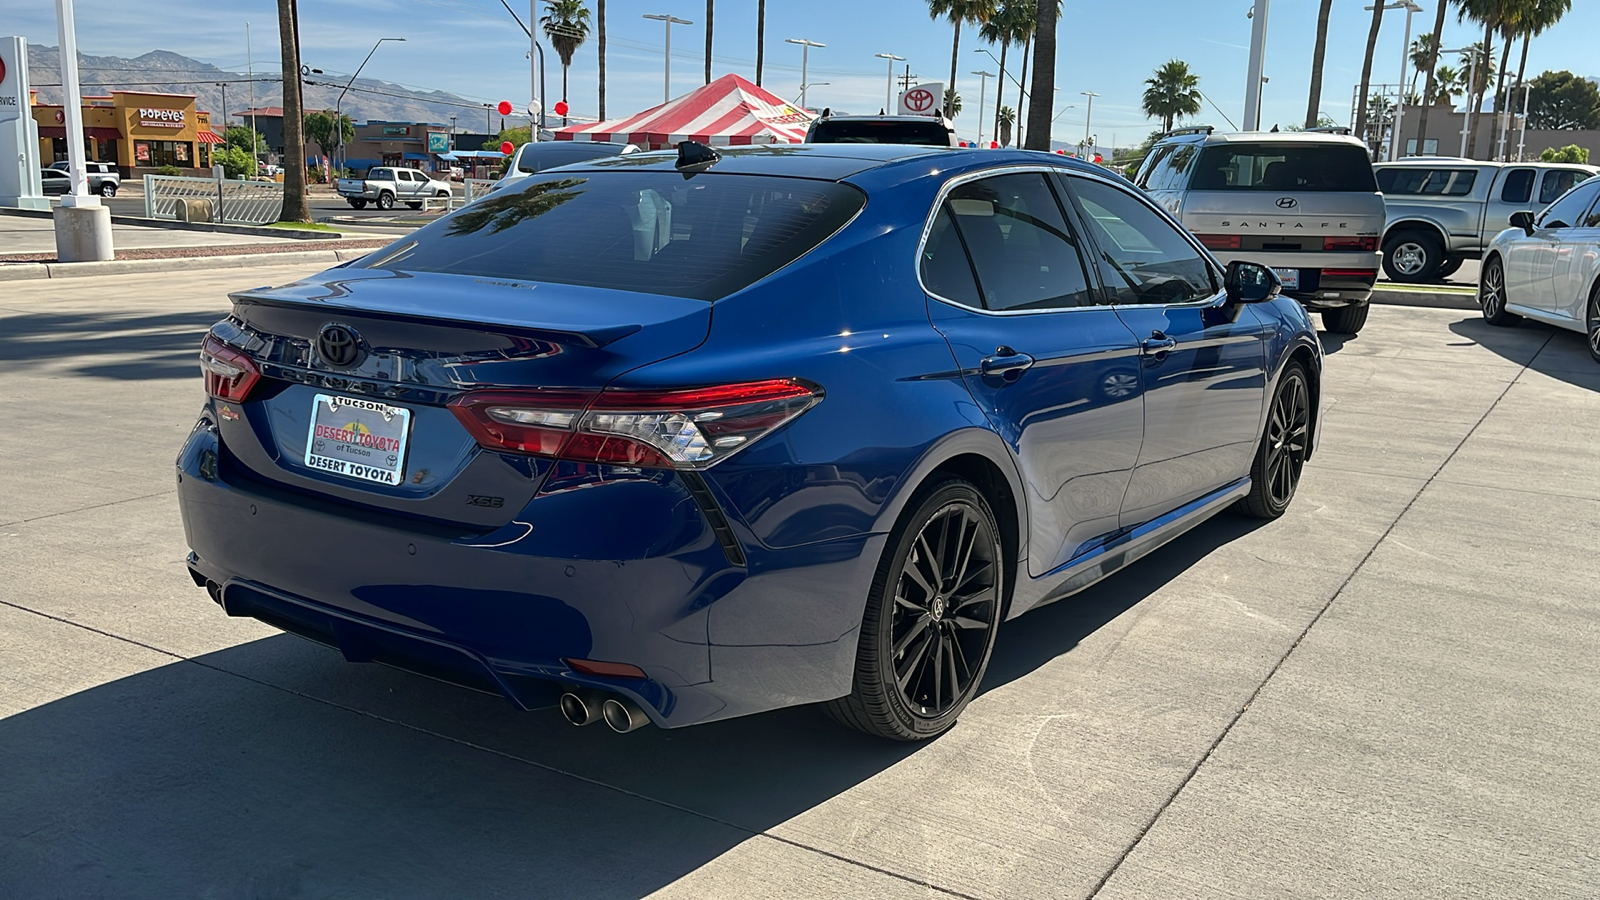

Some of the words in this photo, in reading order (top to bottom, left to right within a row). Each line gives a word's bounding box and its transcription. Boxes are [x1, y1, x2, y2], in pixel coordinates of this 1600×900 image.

[1221, 221, 1304, 229] SANTA
[337, 397, 384, 411] TUCSON
[316, 425, 355, 443] DESERT
[358, 431, 400, 453] TOYOTA
[346, 445, 371, 457] Tucson
[309, 455, 346, 472] DESERT
[349, 464, 394, 483] TOYOTA
[465, 494, 505, 509] XSE
